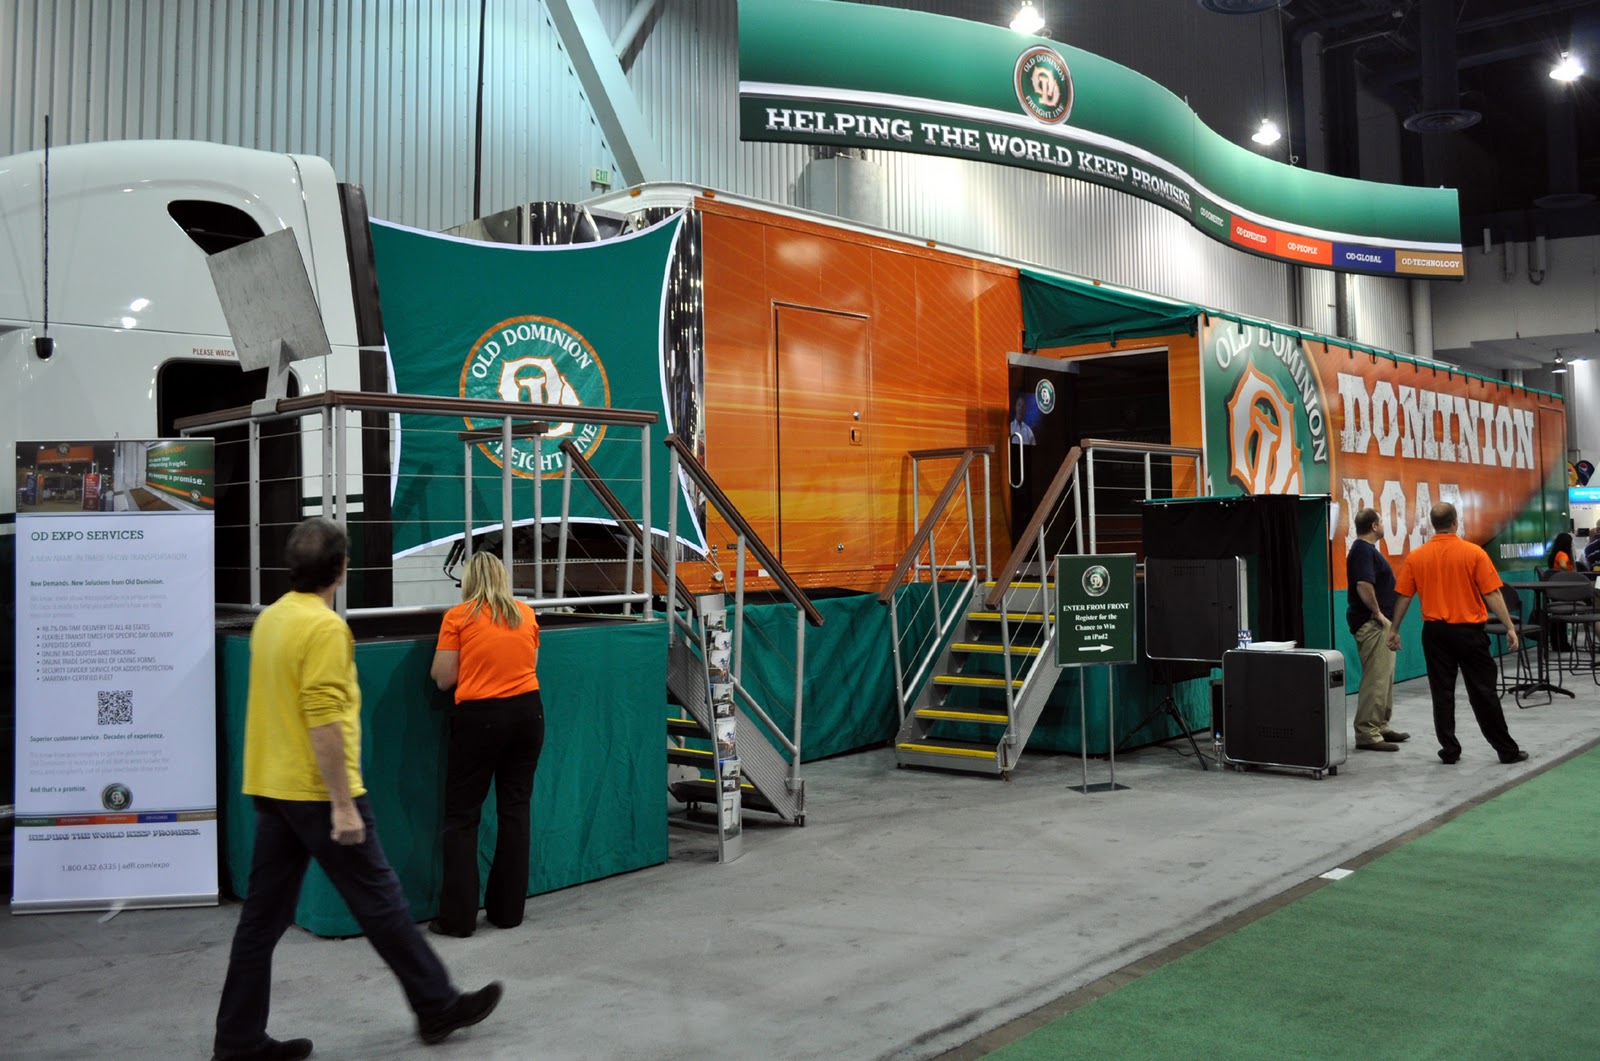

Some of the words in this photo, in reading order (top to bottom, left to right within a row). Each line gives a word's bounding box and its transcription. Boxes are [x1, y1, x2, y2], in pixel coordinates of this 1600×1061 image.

[1023, 58, 1035, 72] OLD
[1036, 54, 1066, 82] DOMINION
[1026, 95, 1052, 118] FREIGHT
[765, 107, 913, 143] HELPING
[921, 123, 980, 152] THE
[986, 132, 1073, 168] WORLD
[1077, 151, 1128, 182] KEEP
[596, 169, 608, 183] EXIT
[1346, 252, 1382, 263] OD-GLOBAL
[1402, 258, 1460, 270] OD-TECHNOLOGY
[192, 348, 214, 356] PLEASE
[472, 340, 501, 379] OLD
[502, 324, 593, 369] DOMINION
[1216, 326, 1252, 368] OLD
[1259, 328, 1326, 462] DOMINION
[1338, 372, 1534, 470] DOMINION
[173, 475, 205, 486] promise.
[31, 531, 49, 541] OD
[52, 531, 84, 541] EXPO
[86, 530, 144, 540] SERVICES
[91, 831, 124, 839] WORLD
